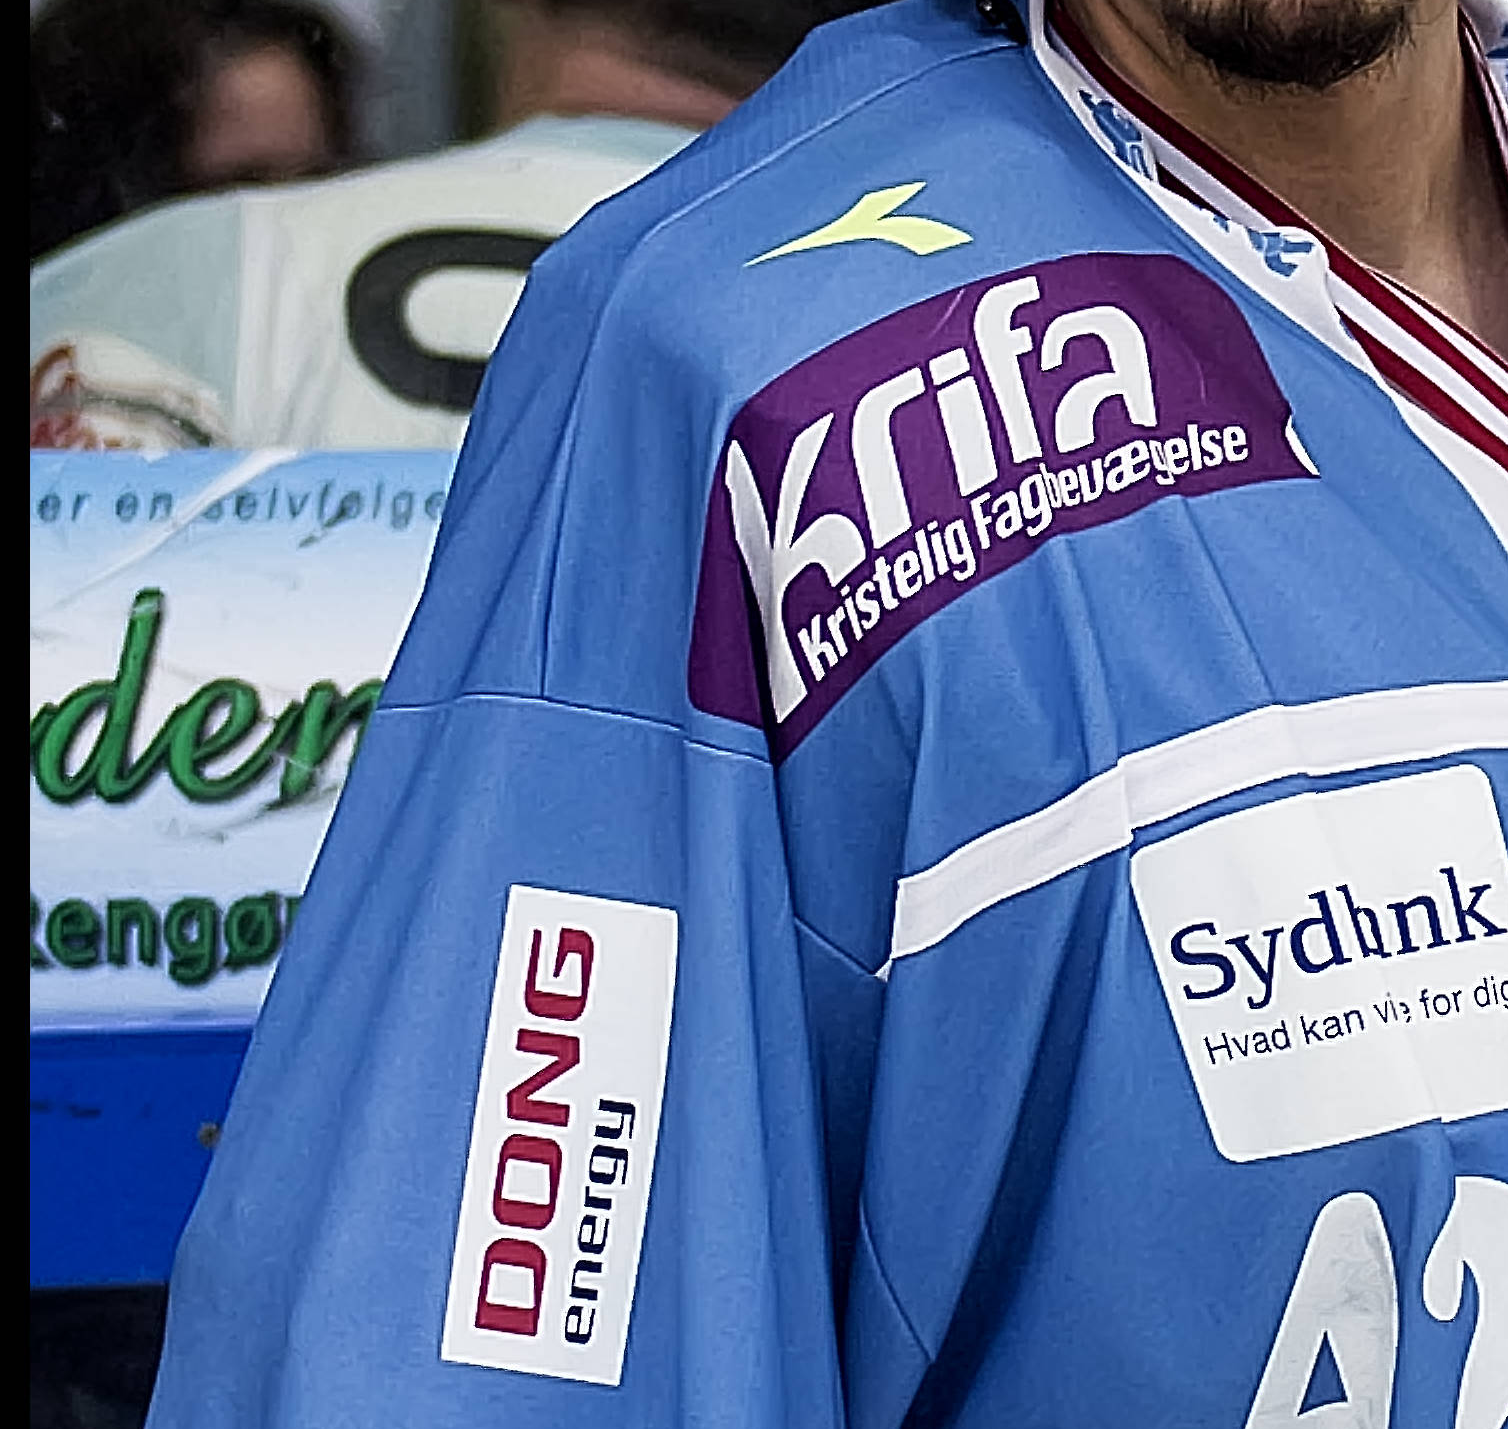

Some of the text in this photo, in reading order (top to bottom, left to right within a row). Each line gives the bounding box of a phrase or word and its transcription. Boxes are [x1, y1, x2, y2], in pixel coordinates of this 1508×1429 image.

[30, 585, 386, 805] den
[797, 521, 978, 681] Kristelig
[474, 926, 594, 1336] DONG
[1205, 1019, 1291, 1065] Hvad
[1300, 1006, 1366, 1046] kan
[1419, 988, 1463, 1021] for
[564, 1097, 635, 1344] energy
